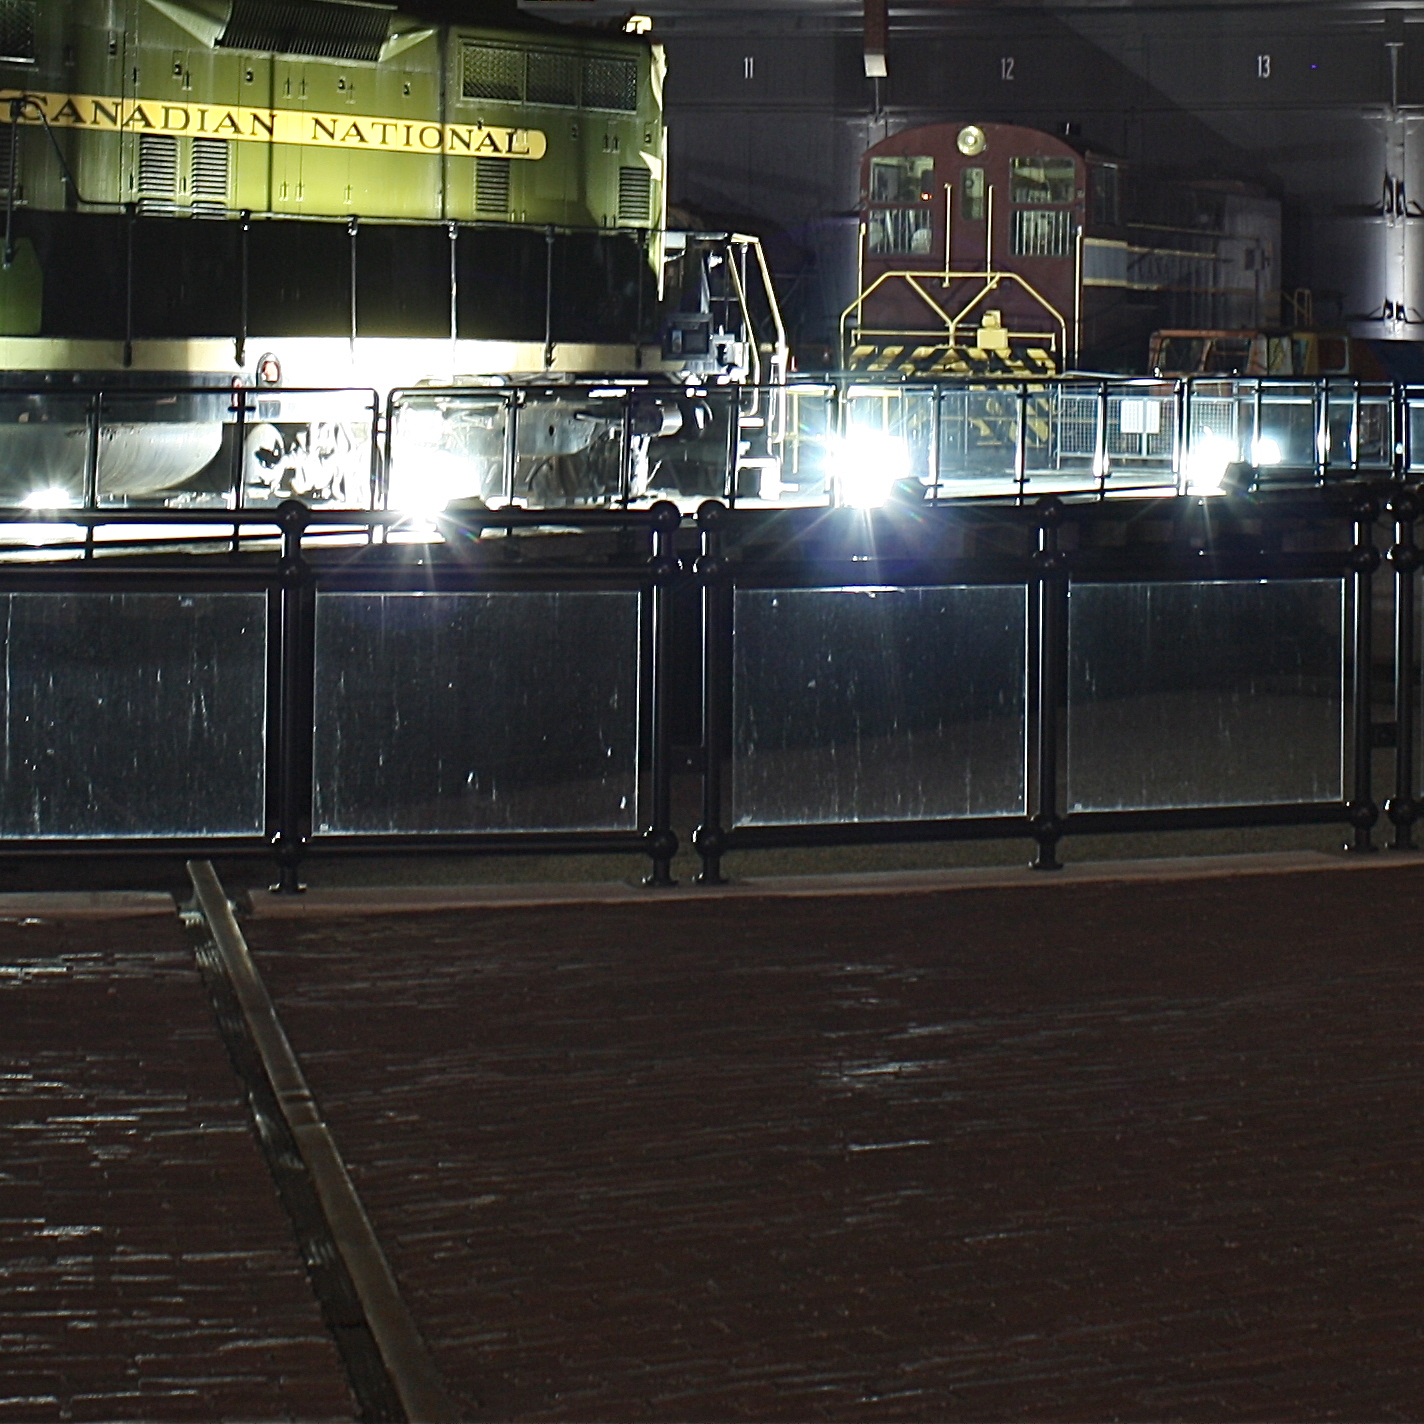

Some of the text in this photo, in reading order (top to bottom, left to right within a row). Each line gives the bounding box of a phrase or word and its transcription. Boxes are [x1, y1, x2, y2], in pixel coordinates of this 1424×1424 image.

[742, 57, 755, 79] 11
[1000, 57, 1016, 80] 12
[1256, 55, 1272, 79] 13
[20, 94, 533, 156] CANADIAN NATIONAL
